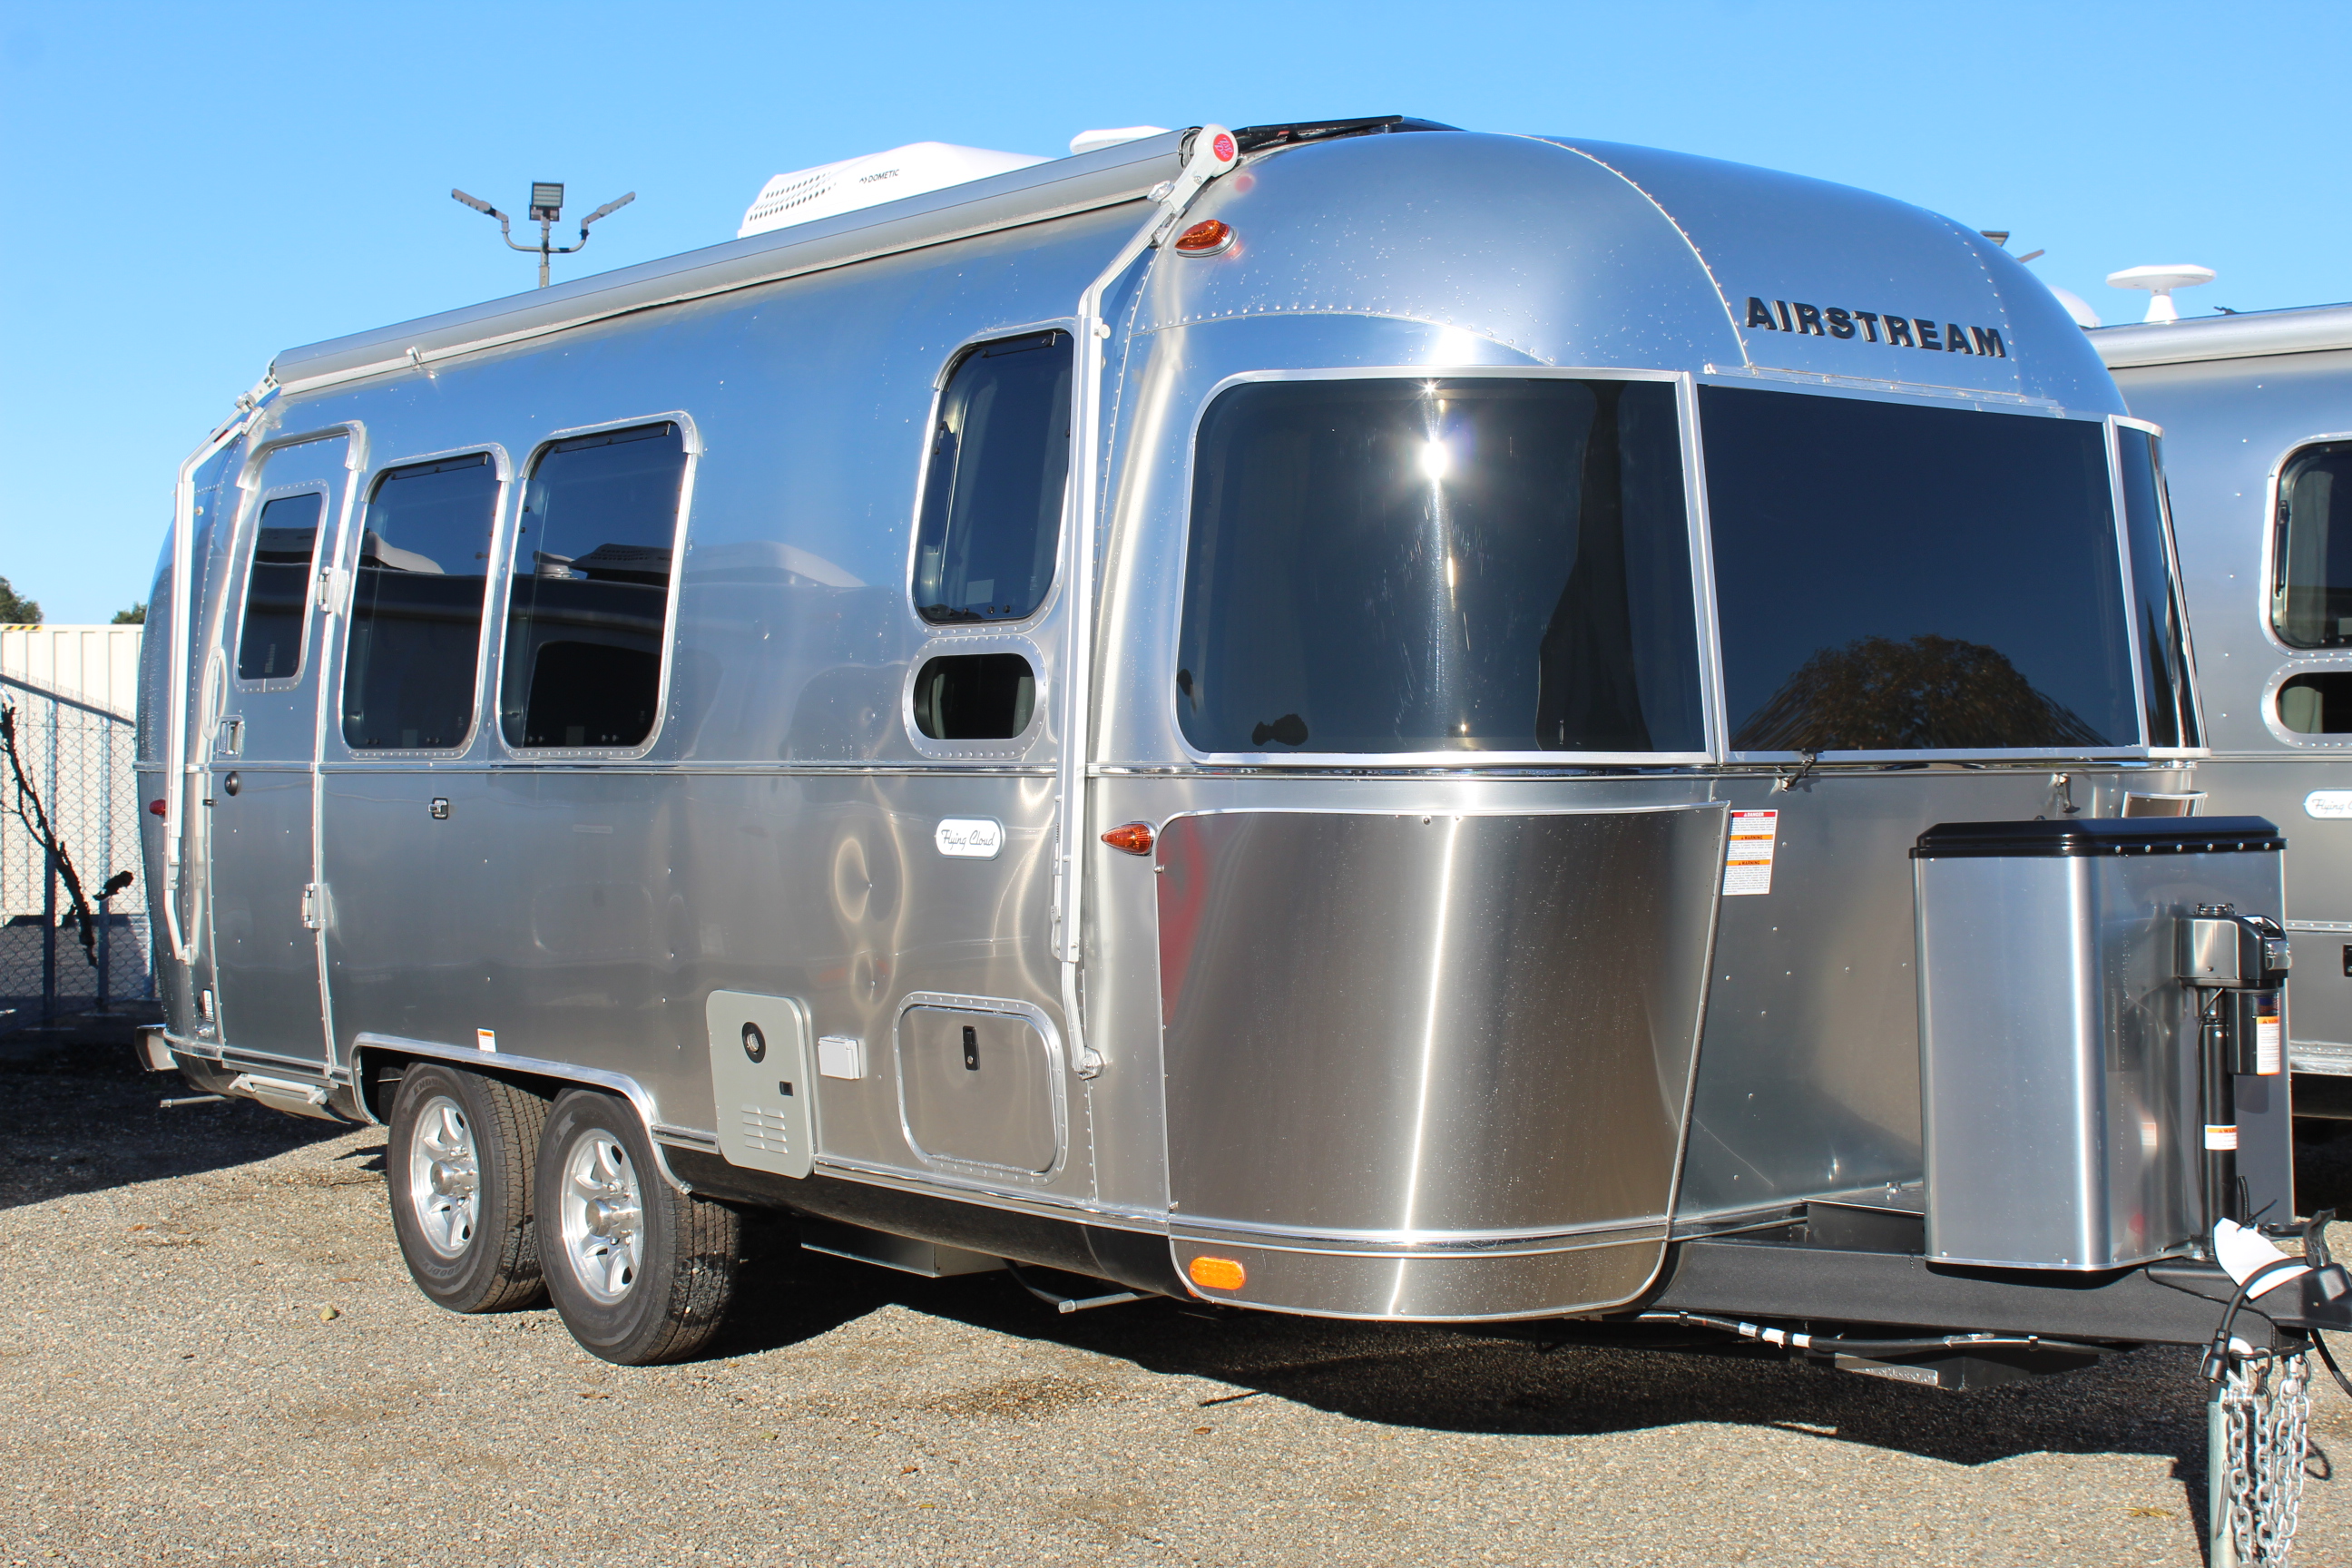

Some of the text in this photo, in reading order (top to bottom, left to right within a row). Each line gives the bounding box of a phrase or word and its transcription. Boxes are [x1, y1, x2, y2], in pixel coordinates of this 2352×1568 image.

[867, 169, 900, 182] DOMETIC
[1745, 296, 2006, 358] AIRSTREAM
[2311, 799, 2345, 815] Flying
[941, 829, 996, 851] Flying Cloud
